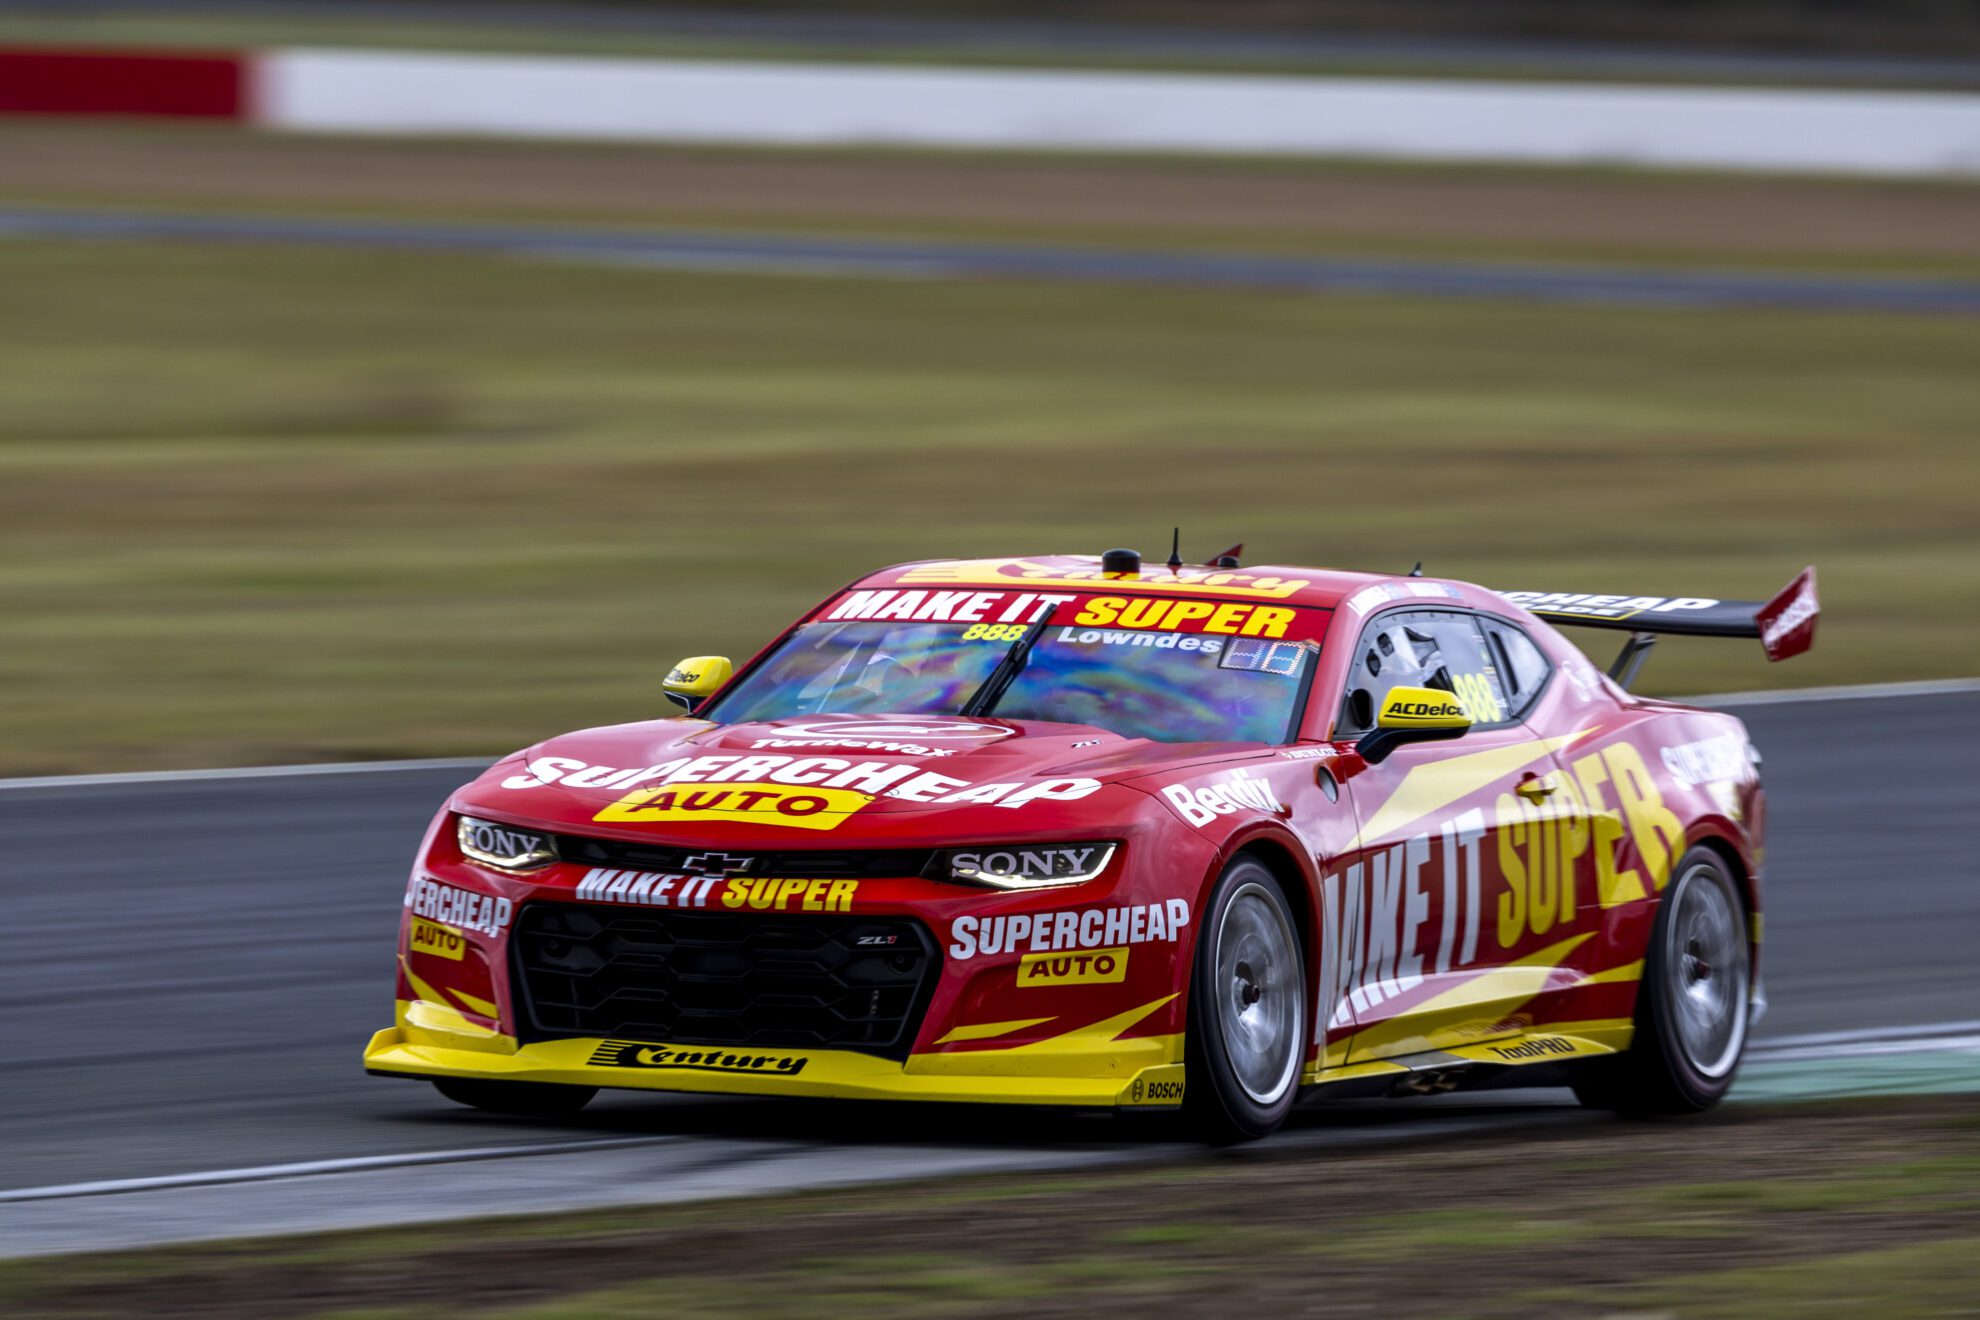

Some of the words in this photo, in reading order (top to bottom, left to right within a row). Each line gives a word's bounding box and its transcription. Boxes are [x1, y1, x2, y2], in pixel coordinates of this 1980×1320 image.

[827, 590, 1005, 622] MAKE
[997, 593, 1077, 623] IT
[1074, 597, 1298, 638] SUPER
[962, 623, 1028, 641] 888
[1057, 626, 1222, 653] Lowndes
[1388, 702, 1465, 716] ACDelco
[1453, 673, 1500, 724] 888
[501, 756, 1103, 809] SUPERCHEAP
[1161, 768, 1285, 828] Bendix
[629, 790, 829, 816] AUTO
[464, 825, 541, 861] SONY
[1435, 807, 1488, 975] IT
[1495, 741, 1687, 949] SUPER
[951, 848, 1094, 878] SONY
[575, 868, 684, 906] MAKE
[677, 875, 723, 907] IT
[720, 877, 860, 912] SUPER
[404, 876, 513, 938] ERCHEAP
[413, 925, 459, 951] AUTO
[856, 935, 898, 945] ZL1
[950, 898, 1190, 960] SUPERCHEAP
[1028, 955, 1116, 978] AUTO
[586, 1038, 809, 1076] Century
[1487, 1036, 1578, 1061] ToolPRO
[1147, 1081, 1184, 1099] BOSCH
